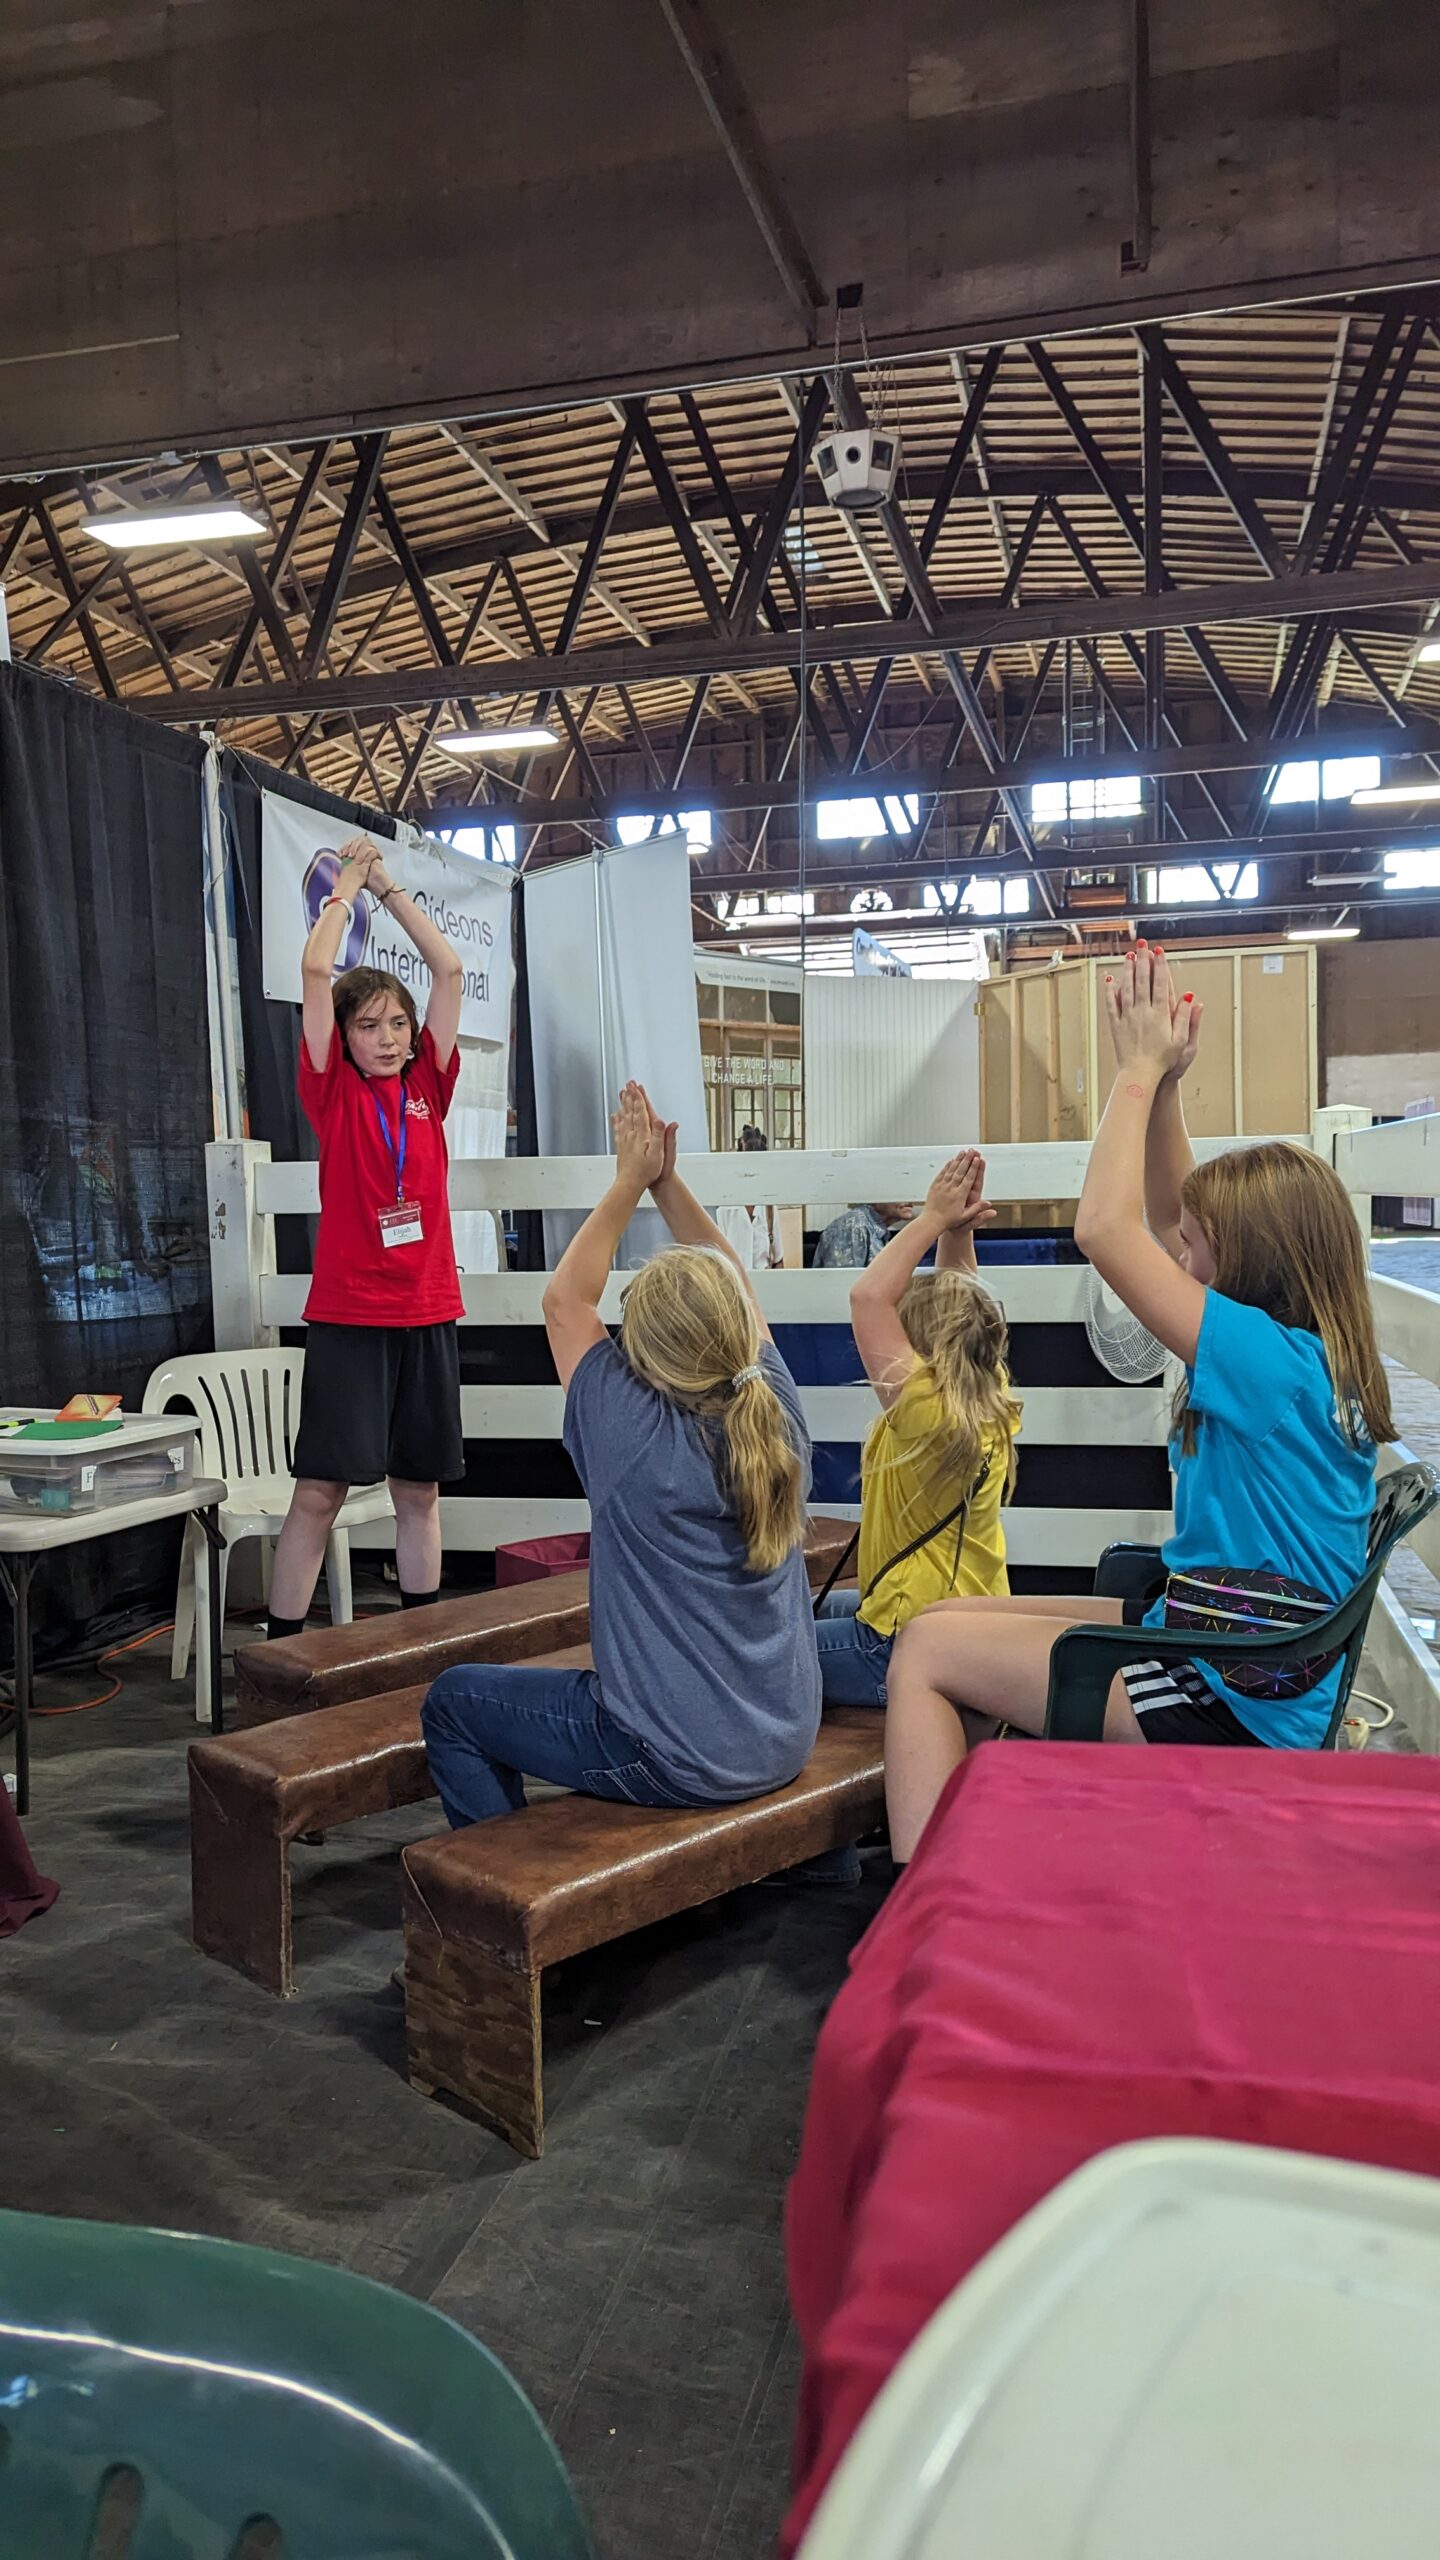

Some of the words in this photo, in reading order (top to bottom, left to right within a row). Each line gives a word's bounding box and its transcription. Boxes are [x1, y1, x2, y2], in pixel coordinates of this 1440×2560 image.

[371, 935, 490, 1002] Internnal
[704, 1055, 722, 1068] GIVE
[725, 1057, 741, 1069] THE
[744, 1058, 767, 1070] WORD
[769, 1060, 784, 1071] AND
[712, 1072, 746, 1084] CHANGE
